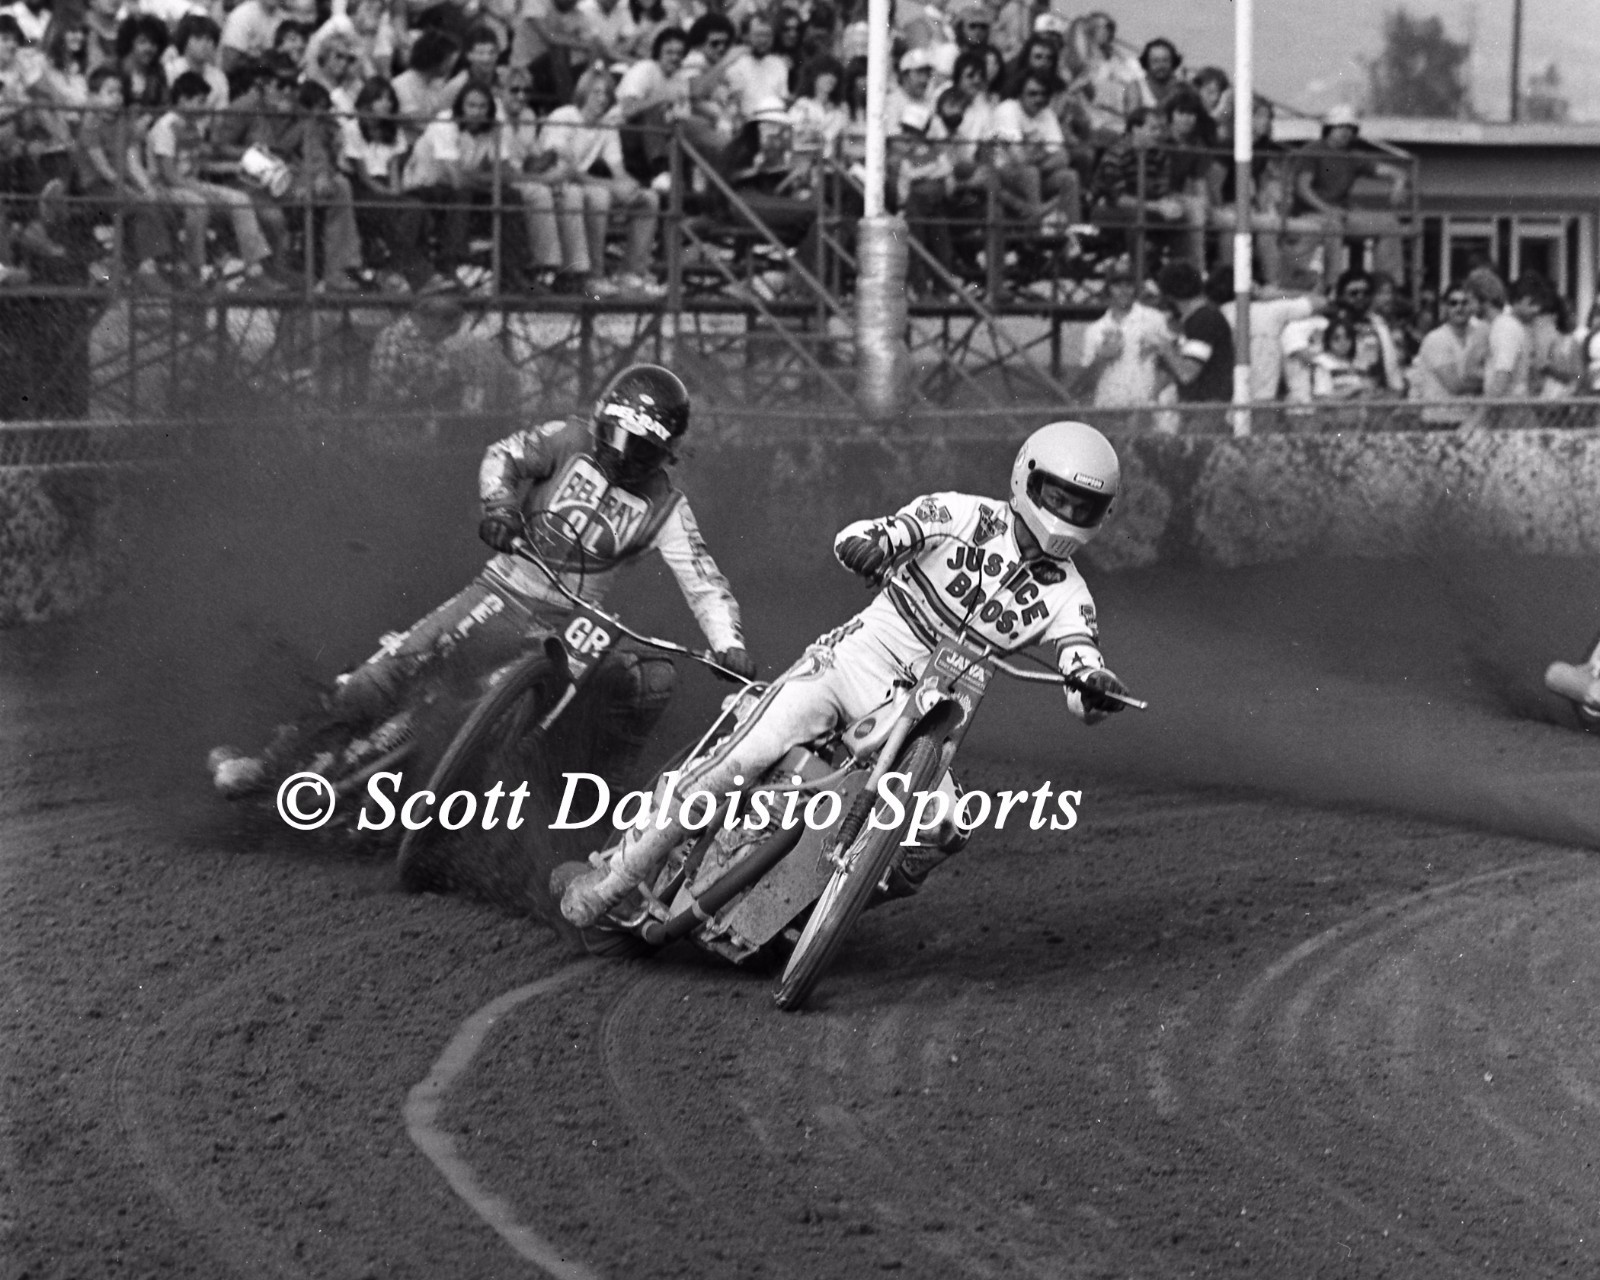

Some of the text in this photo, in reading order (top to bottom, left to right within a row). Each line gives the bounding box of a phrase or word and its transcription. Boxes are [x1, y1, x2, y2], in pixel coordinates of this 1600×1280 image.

[945, 571, 1019, 640] BROS.
[946, 546, 1050, 627] JUSTICE
[946, 652, 985, 683] JAWA
